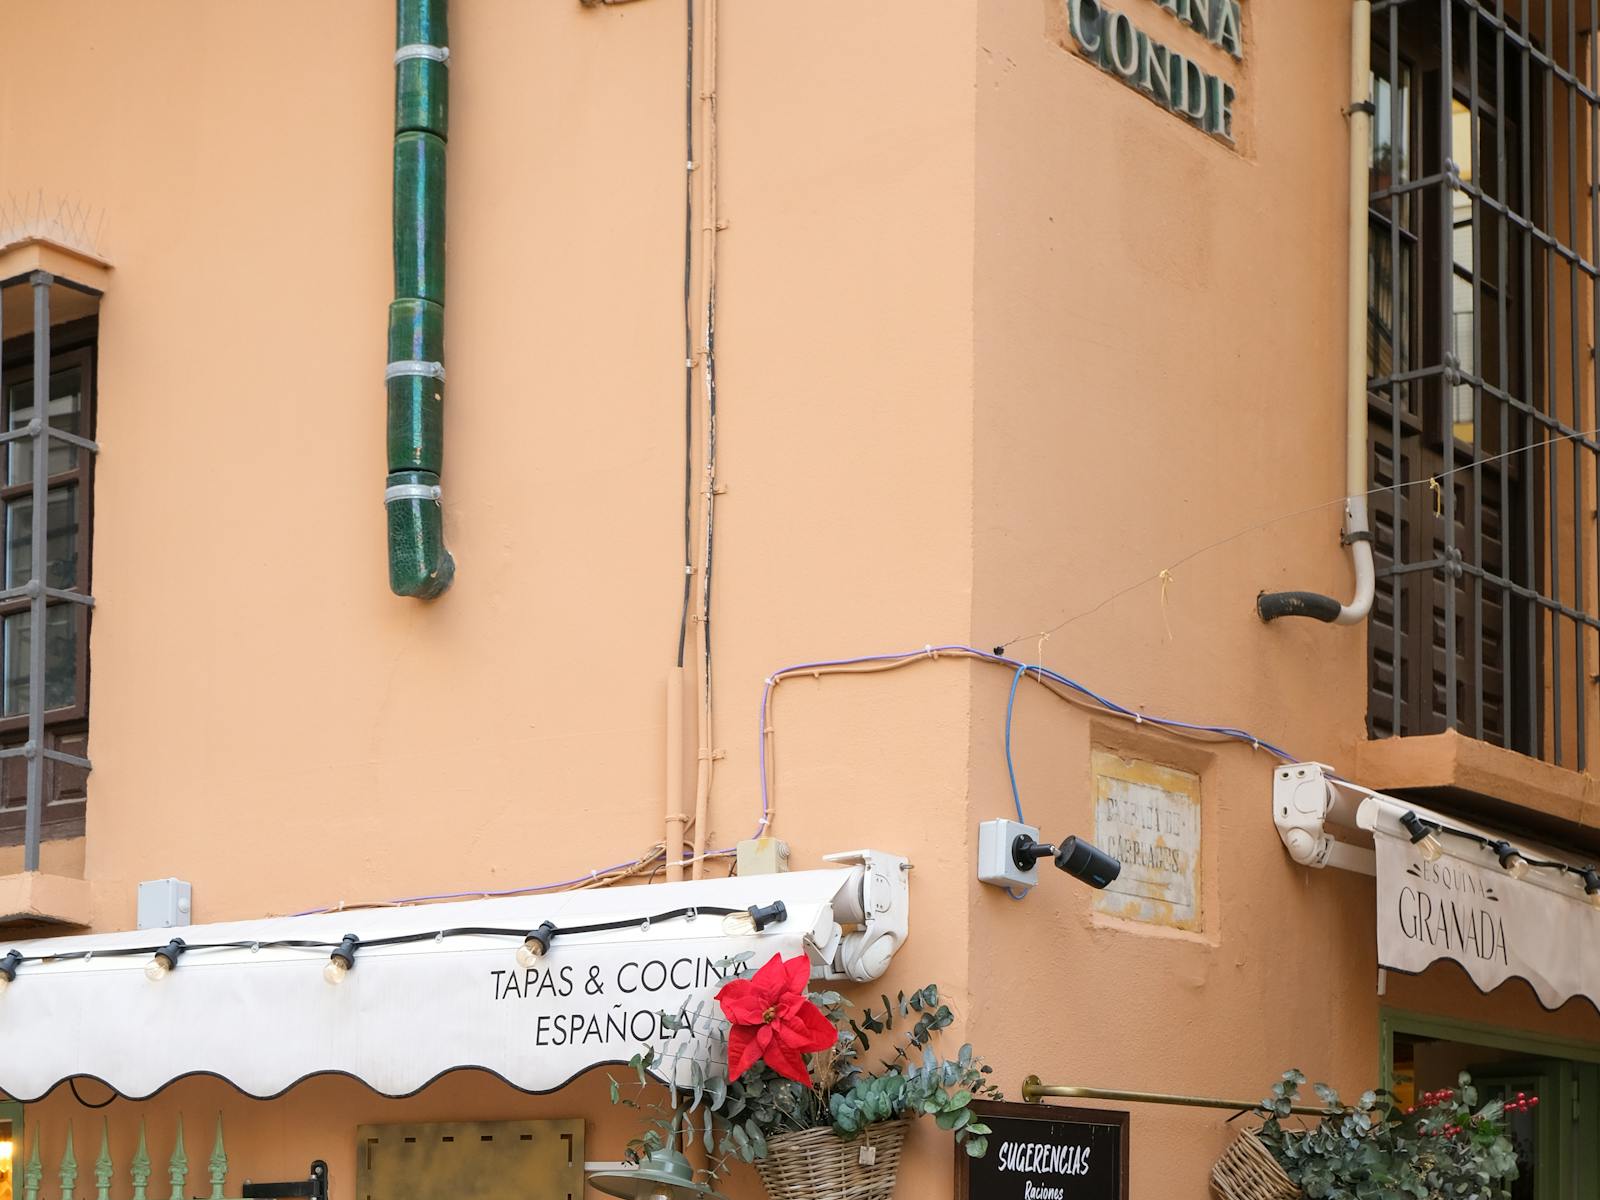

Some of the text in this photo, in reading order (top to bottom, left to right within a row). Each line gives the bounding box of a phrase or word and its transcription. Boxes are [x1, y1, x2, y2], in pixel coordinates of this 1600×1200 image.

[1423, 861, 1485, 897] ESQUINA
[1399, 887, 1508, 966] GRANADA
[491, 966, 574, 999] TAPAS
[584, 965, 604, 995] &
[536, 1004, 696, 1046] ESPAÑOLA
[998, 1142, 1090, 1175] SUGERENCIAS
[1025, 1180, 1063, 1200] Raciones
